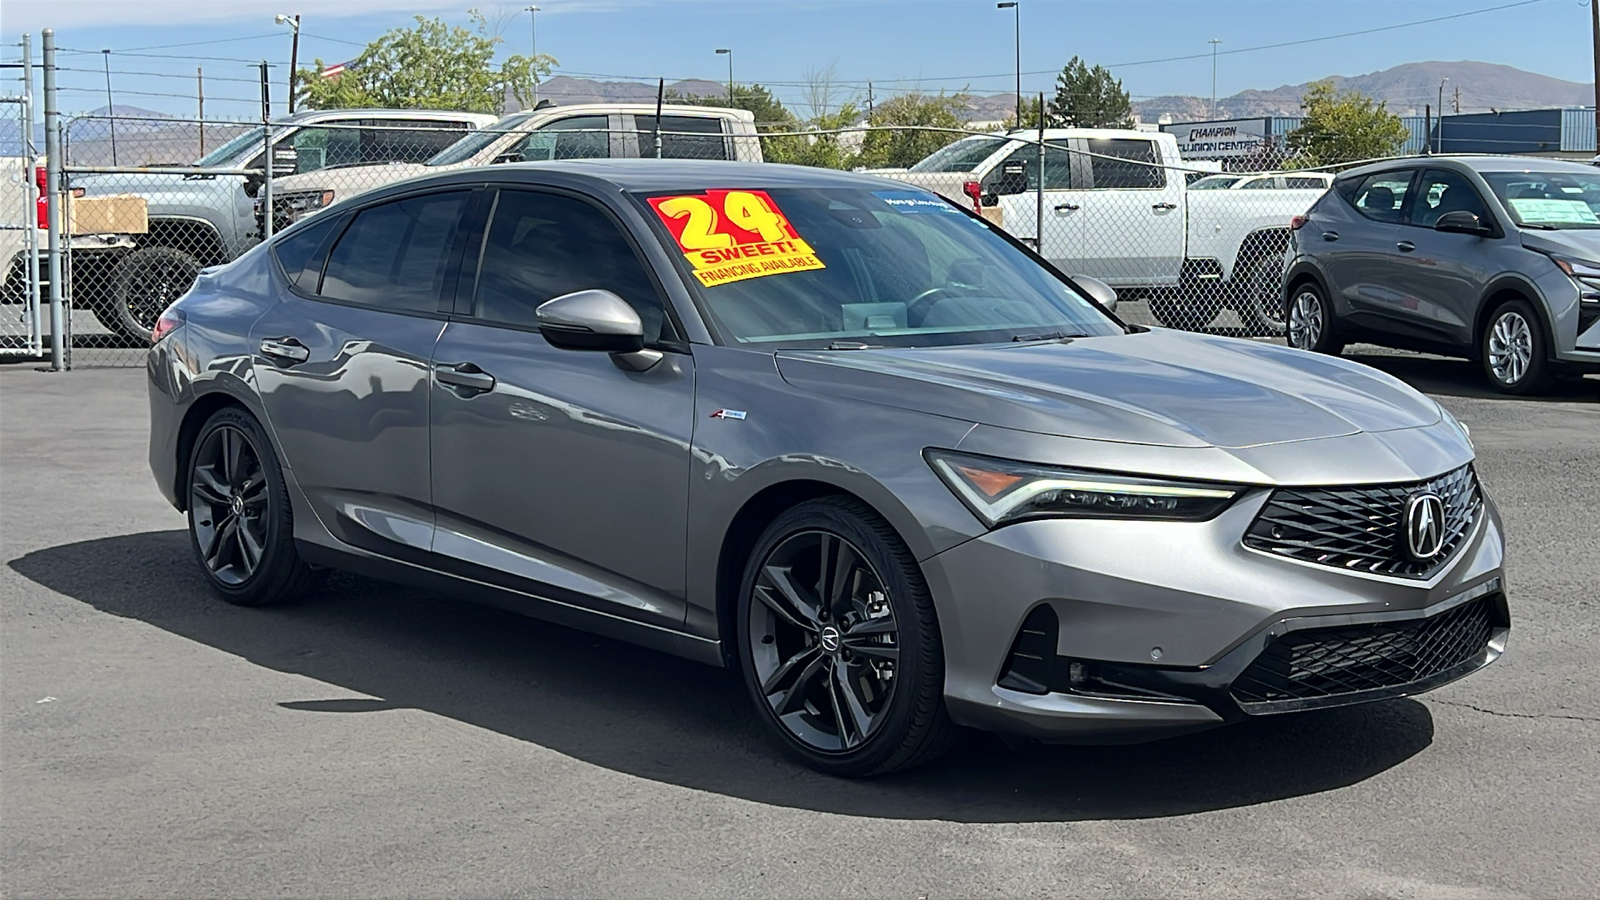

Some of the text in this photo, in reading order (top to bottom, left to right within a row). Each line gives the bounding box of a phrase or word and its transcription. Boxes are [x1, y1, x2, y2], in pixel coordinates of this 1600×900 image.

[1189, 126, 1237, 142] CHAMPION
[658, 191, 795, 250] 24
[700, 241, 797, 264] SWEET!
[699, 256, 819, 284] FINANCING AVAILABLE
